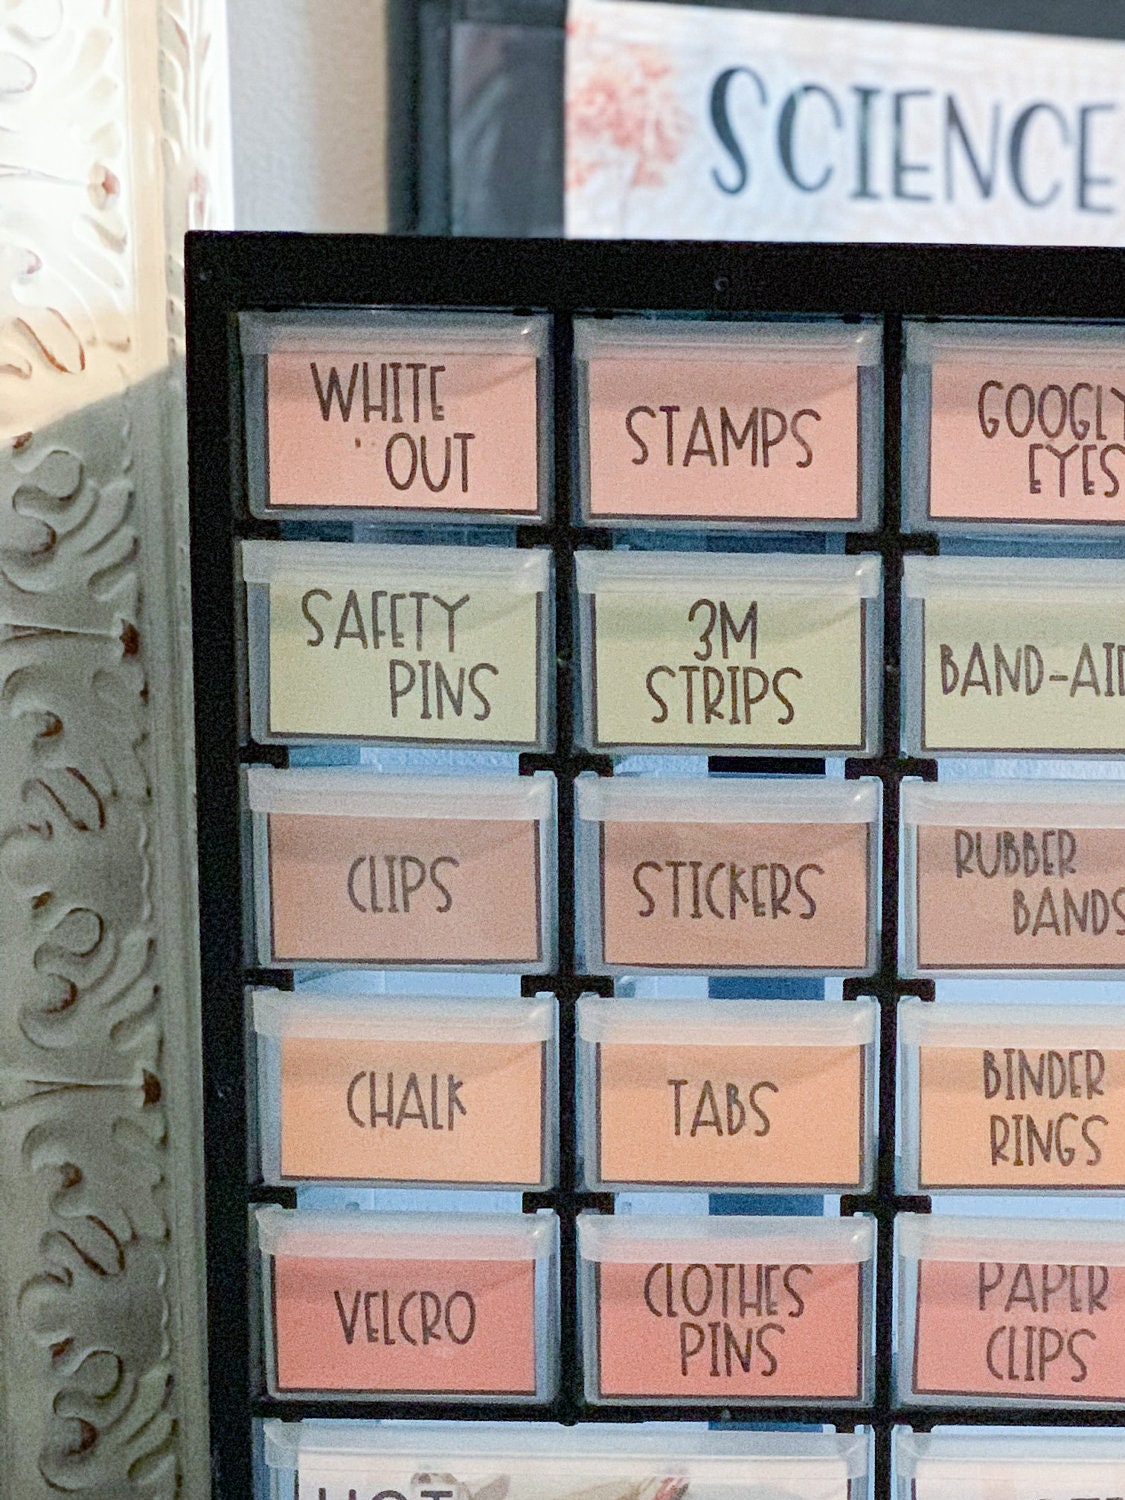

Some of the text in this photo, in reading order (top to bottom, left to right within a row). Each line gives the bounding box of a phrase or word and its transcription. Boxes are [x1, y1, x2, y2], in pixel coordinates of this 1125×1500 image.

[707, 65, 1119, 215] SCIENCE
[310, 362, 446, 422] WHITE
[385, 432, 476, 494] OUT
[625, 405, 821, 469] STAMPS
[300, 588, 470, 652] SAFETY
[687, 599, 758, 661] 3M
[388, 659, 500, 722] PINS
[645, 665, 803, 725] STRIPS
[954, 828, 1078, 879] RUBBER
[347, 856, 461, 913] CLIPS
[632, 861, 825, 920] STICKERS
[346, 1070, 468, 1132] CHALK
[983, 1048, 1106, 1100] BINDER
[667, 1079, 779, 1138] TABS
[990, 1113, 1109, 1167] RINGS
[644, 1262, 814, 1319] CLOTHES
[978, 1261, 1111, 1312] PAPER
[334, 1289, 476, 1346] VELCRO
[678, 1323, 786, 1378] PINS
[985, 1325, 1097, 1383] CLIPS
